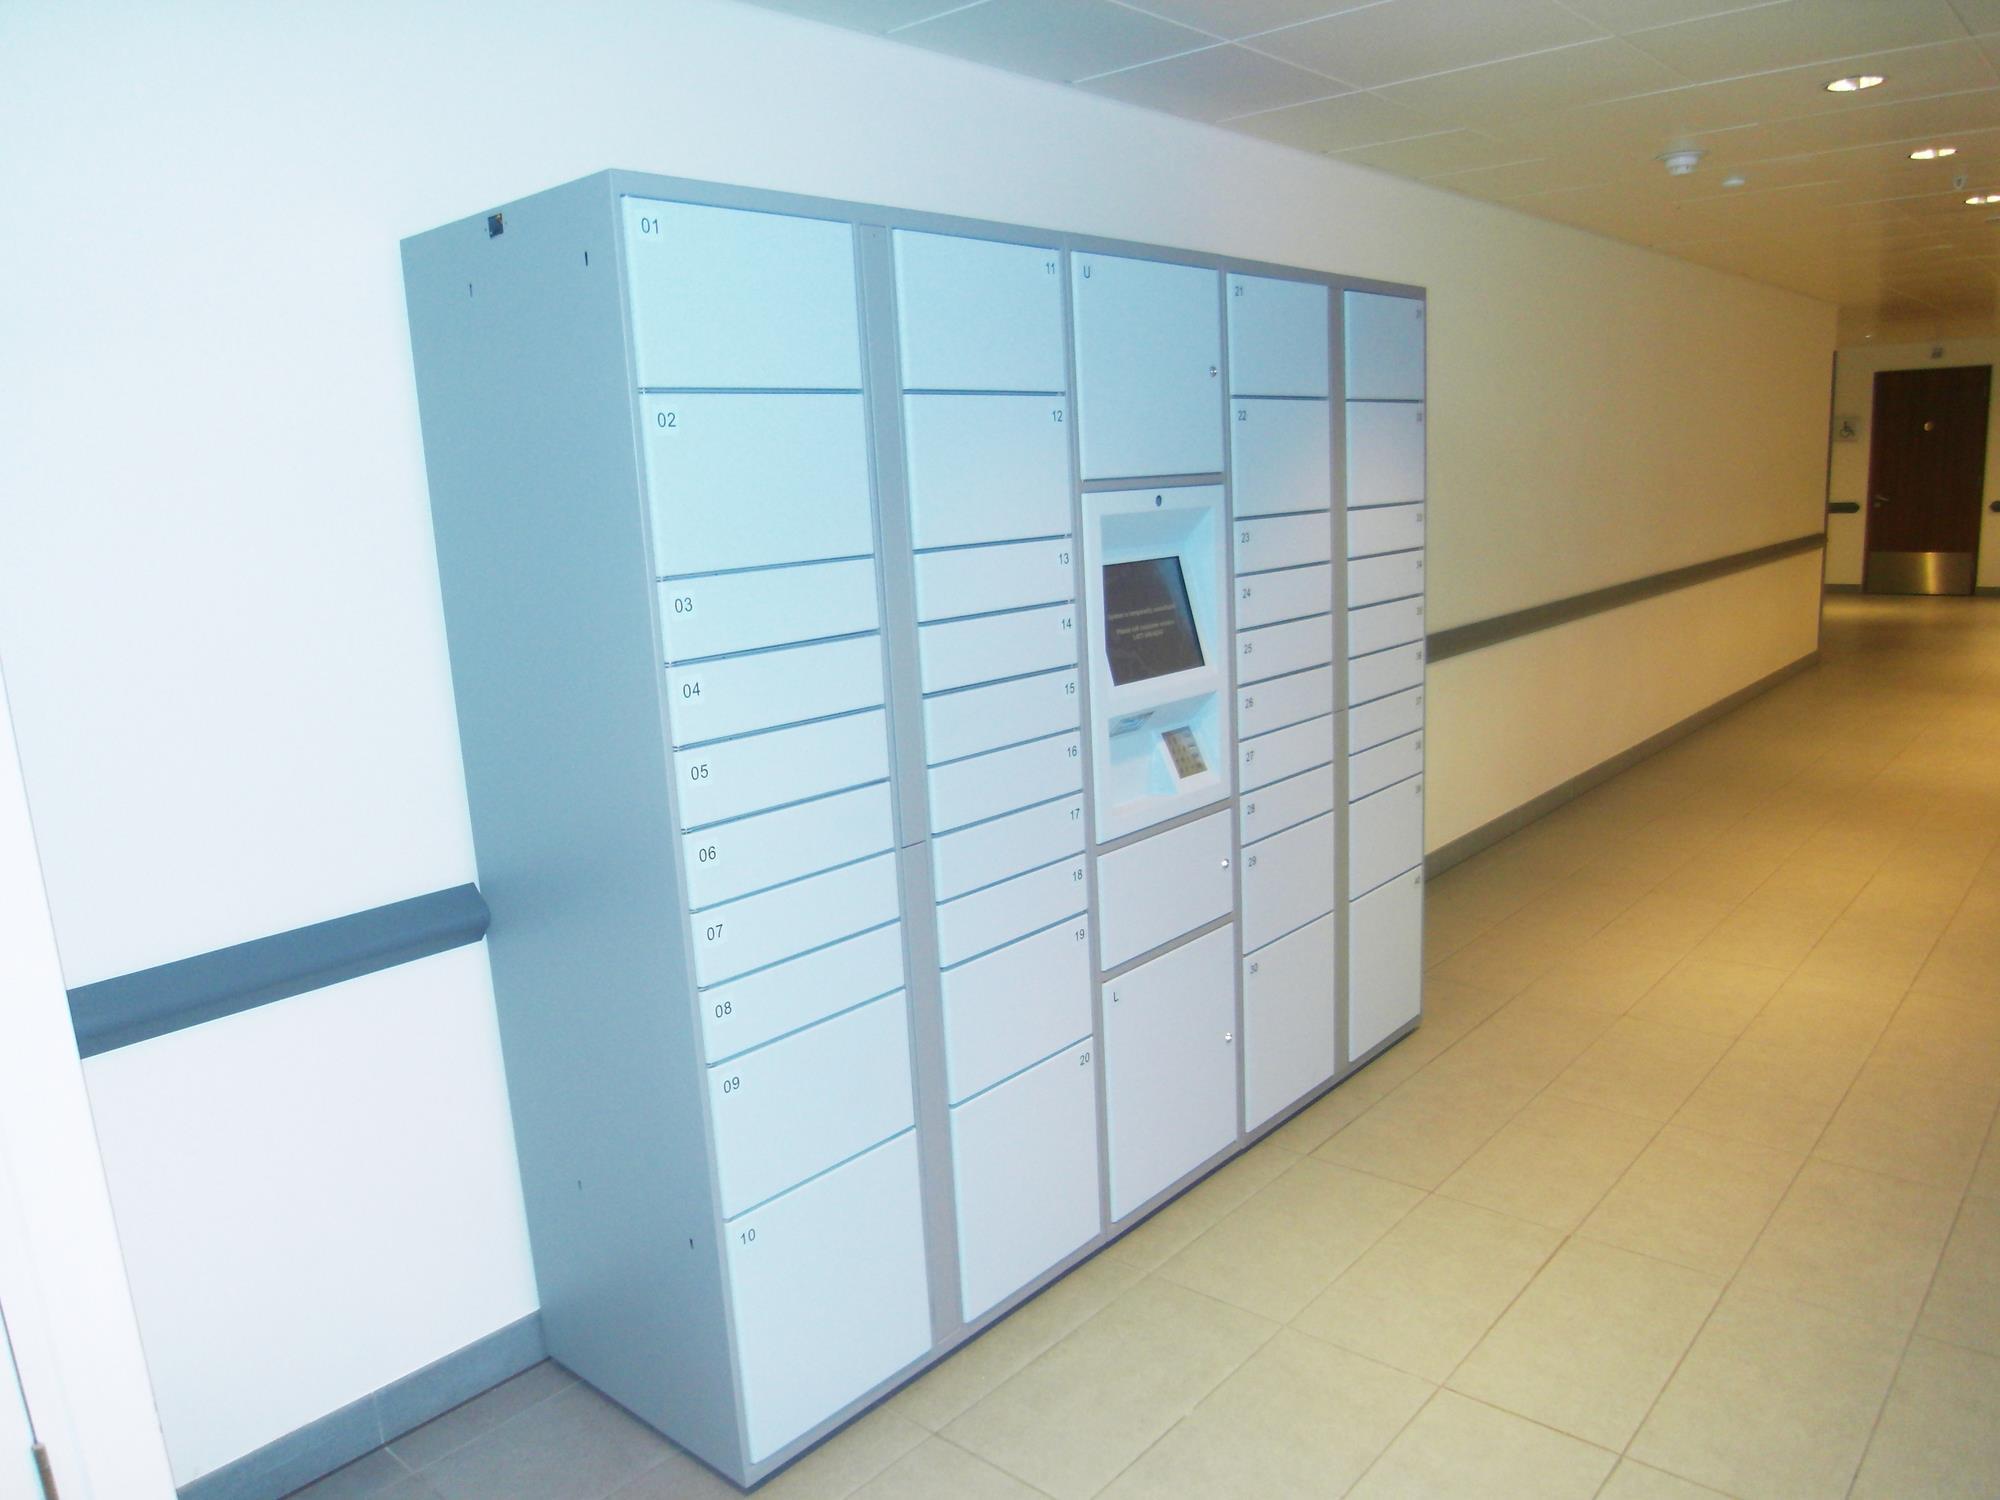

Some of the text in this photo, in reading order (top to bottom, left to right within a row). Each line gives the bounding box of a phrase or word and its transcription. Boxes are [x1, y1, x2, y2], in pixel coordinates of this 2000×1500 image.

[641, 217, 659, 234] 01
[1045, 262, 1055, 274] 11
[1083, 264, 1091, 280] U
[1234, 285, 1244, 297] 21
[657, 412, 677, 428] 02
[1052, 409, 1063, 423] 12
[1237, 409, 1247, 422] 22
[1240, 531, 1250, 544] 23
[1059, 552, 1070, 565] 13
[1242, 587, 1252, 599] 24
[674, 597, 693, 614] 03
[1061, 617, 1072, 629] 14
[1243, 642, 1253, 655] 25
[682, 681, 701, 699] 04
[1064, 682, 1075, 695] 15
[1067, 745, 1078, 758] 16
[1245, 750, 1255, 763] 27
[690, 763, 709, 781] 05
[1070, 807, 1081, 820] 17
[698, 845, 717, 863] 06
[1248, 855, 1257, 868] 29
[1072, 868, 1083, 881] 18
[706, 923, 723, 941] 07
[1075, 928, 1085, 942] 19
[1113, 991, 1120, 1003] L
[714, 1000, 732, 1019] 08
[1079, 1051, 1091, 1066] 20
[723, 1076, 740, 1094] 09
[740, 1228, 756, 1245] 10
